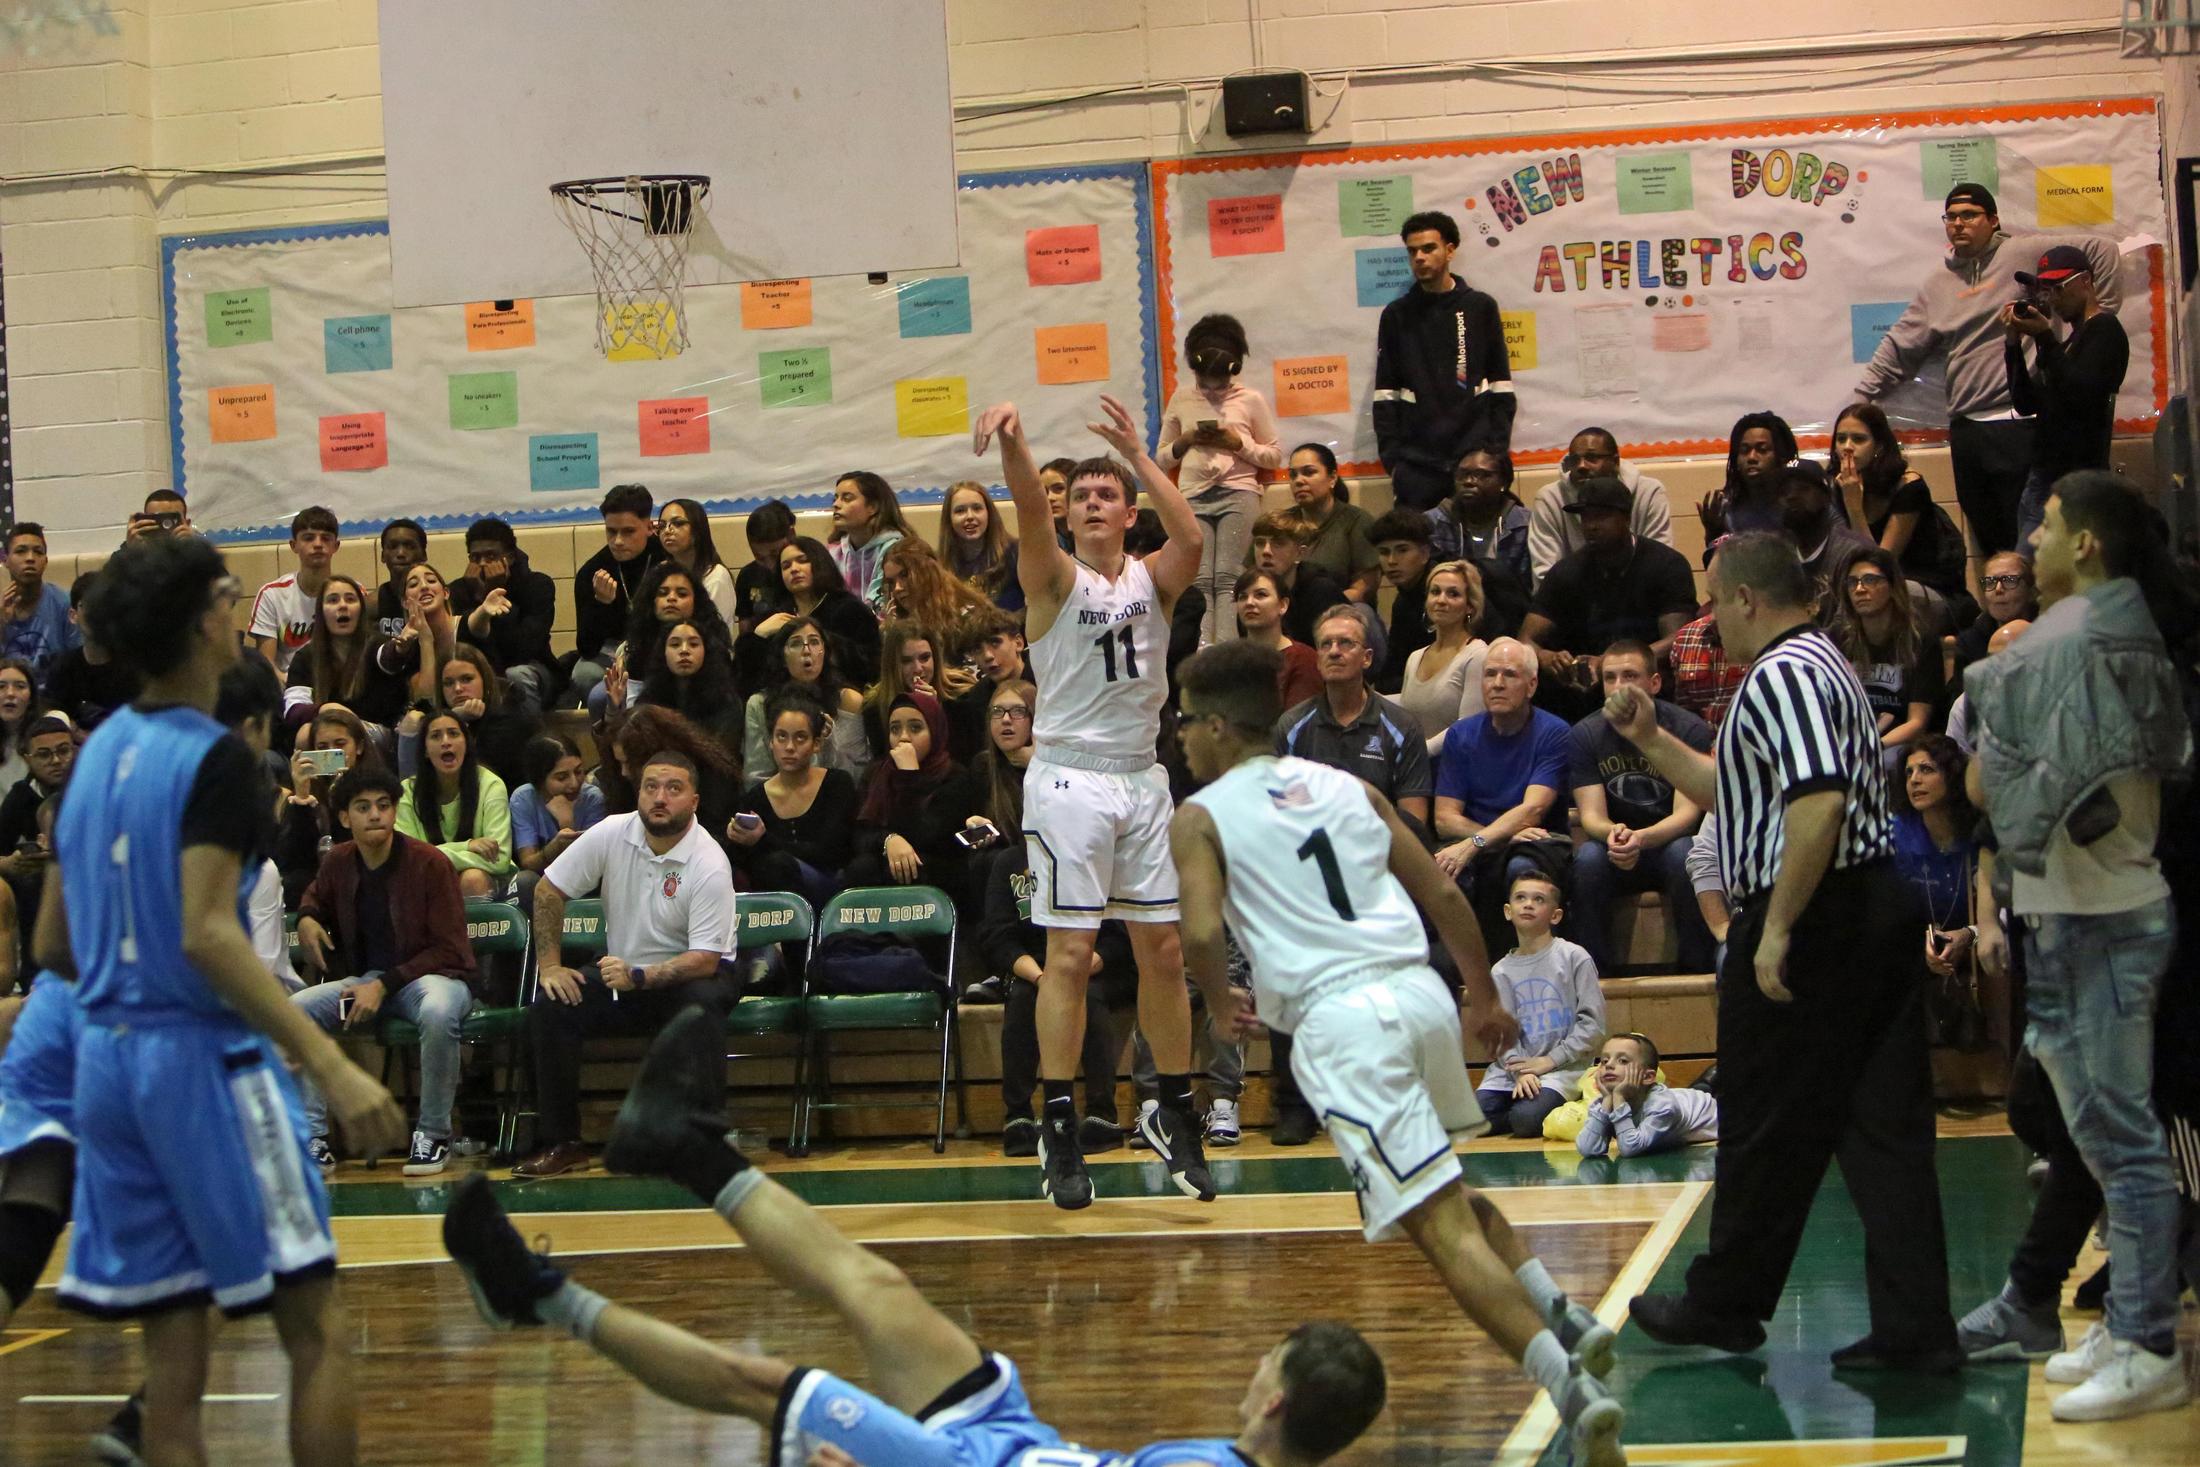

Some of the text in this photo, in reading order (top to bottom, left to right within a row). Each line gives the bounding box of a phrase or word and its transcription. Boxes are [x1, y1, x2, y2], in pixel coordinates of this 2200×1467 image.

[1486, 149, 1849, 232] NEW DORP
[2046, 188, 2080, 196] MEDICAL
[1534, 231, 1807, 293] ATHLETICS
[337, 325, 381, 336] Cell phone
[1455, 311, 1467, 364] Motorsport
[784, 359, 800, 367] Two
[1282, 364, 1338, 376] IS SIGNED BY
[779, 369, 815, 382] prepared
[1288, 379, 1335, 391] A DOCTOR
[218, 392, 267, 406] Unprepared
[561, 454, 592, 463] Property
[1078, 610, 1110, 625] NEW
[1094, 624, 1140, 683] 11
[1297, 826, 1357, 922] 1
[748, 909, 794, 928] DORP
[840, 903, 936, 923] NEW DORP
[466, 920, 511, 939] DORP
